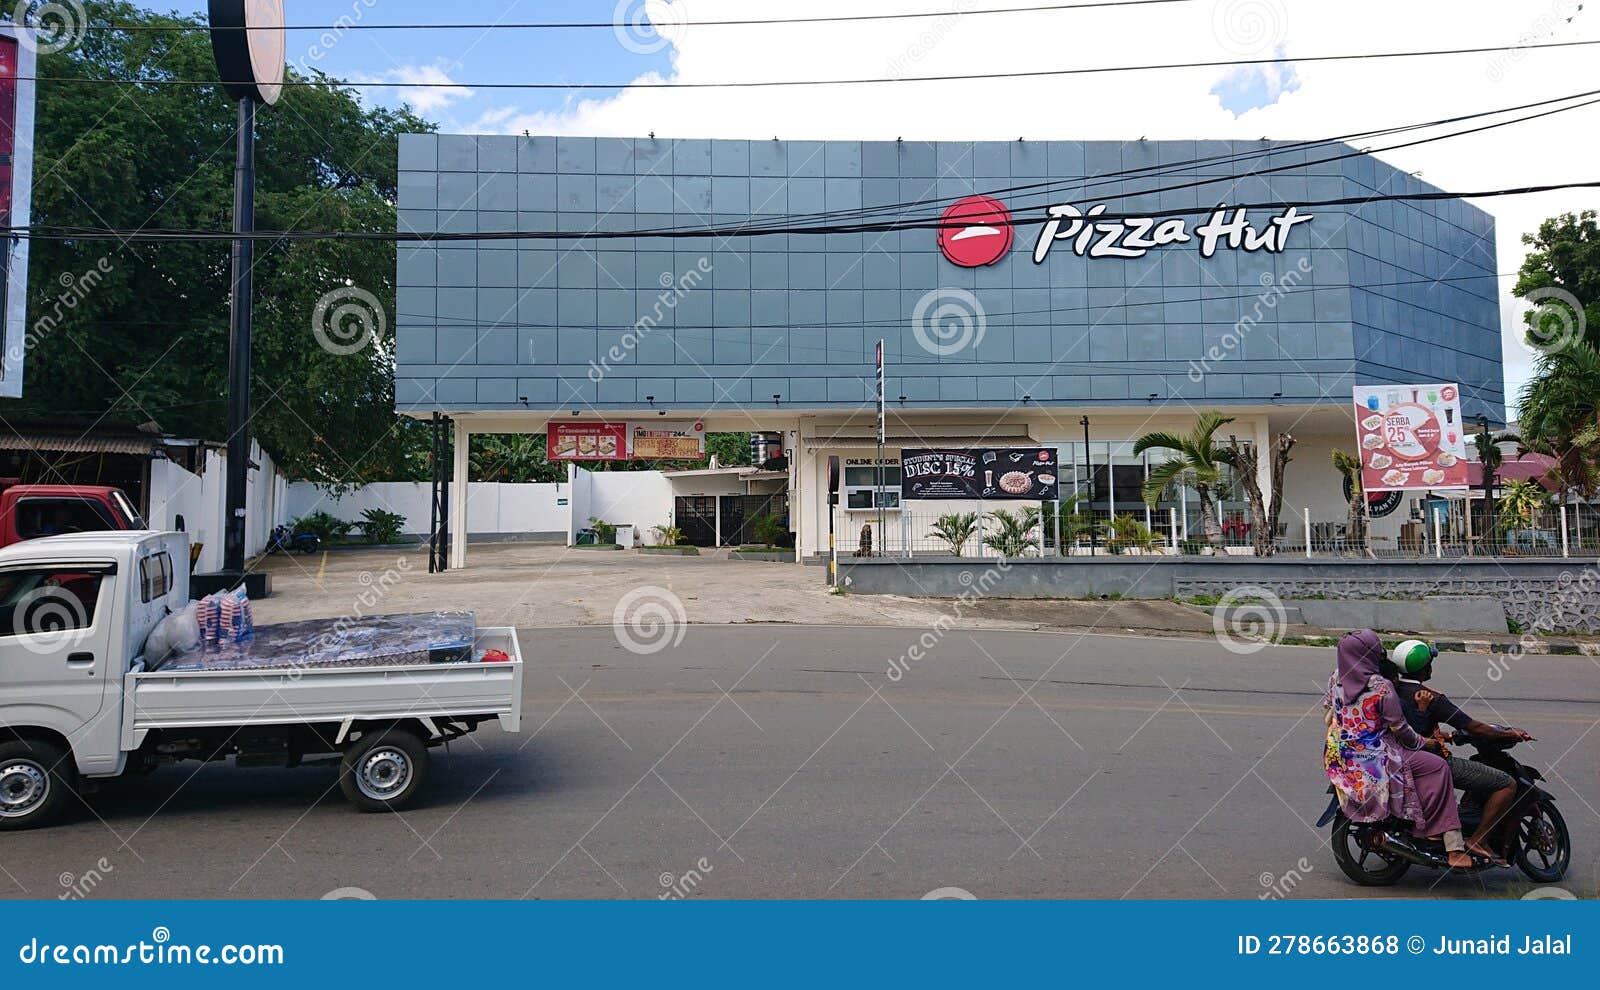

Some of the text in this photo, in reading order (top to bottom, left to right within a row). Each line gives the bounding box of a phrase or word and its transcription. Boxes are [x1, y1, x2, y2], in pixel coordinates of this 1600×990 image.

[1033, 203, 1314, 264] Pizza Hut
[1386, 416, 1411, 426] SERBA
[1387, 426, 1406, 443] 25
[904, 461, 975, 478] DISC 15%
[1374, 502, 1389, 512] PAN
